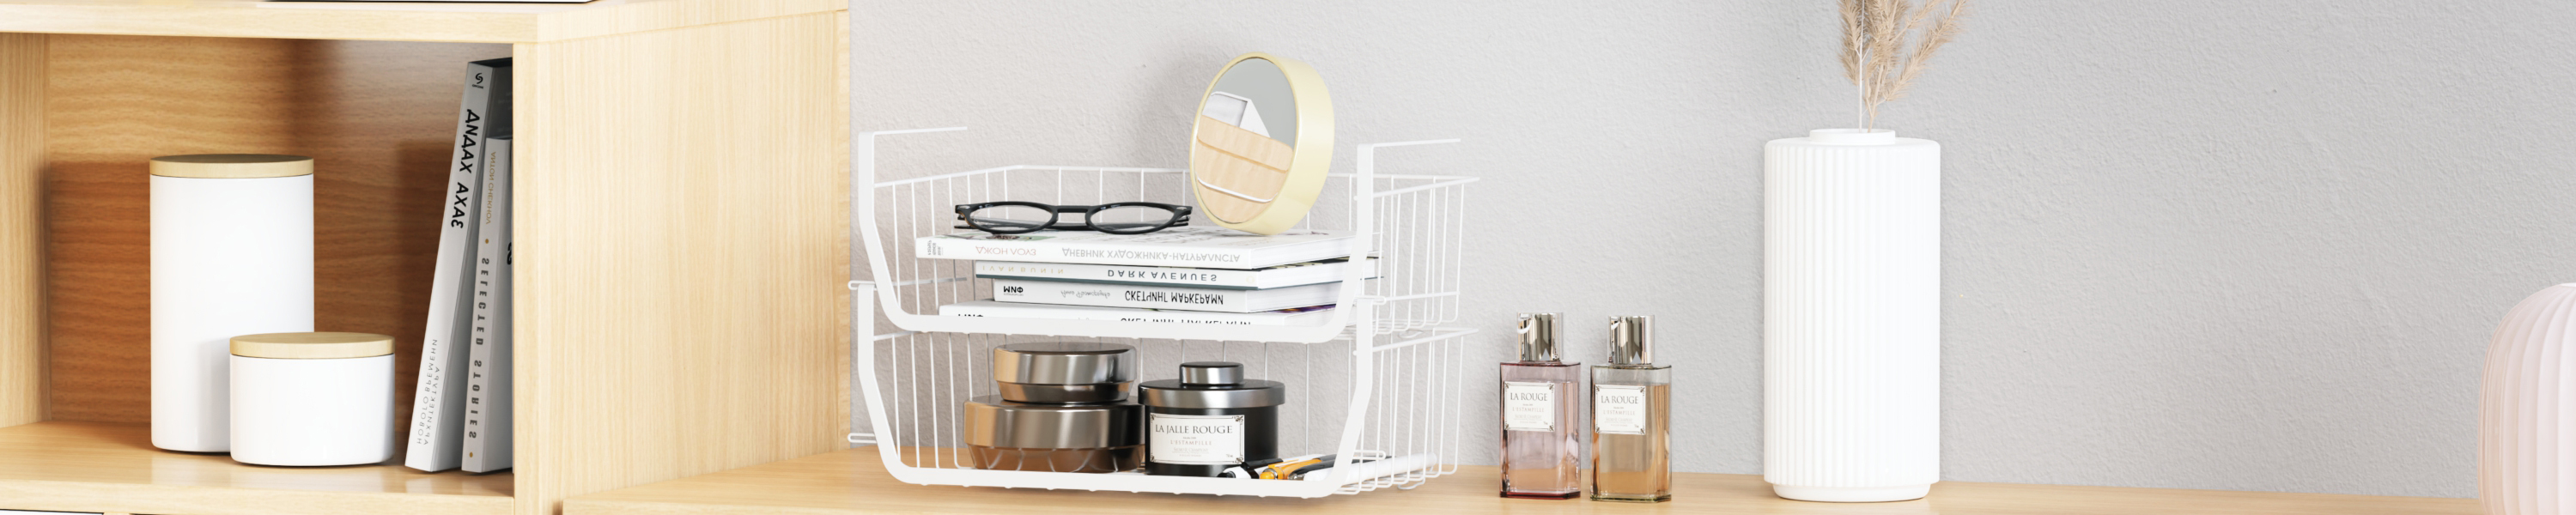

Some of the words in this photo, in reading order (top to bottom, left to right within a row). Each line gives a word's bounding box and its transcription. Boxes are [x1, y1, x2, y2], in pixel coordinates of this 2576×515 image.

[1510, 392, 1519, 401] LA
[1521, 393, 1548, 402] ROUGE
[1612, 396, 1639, 404] ROUGE
[1155, 424, 1164, 433] LA
[1166, 425, 1189, 434] JALLE
[1193, 426, 1233, 434] ROUGE
